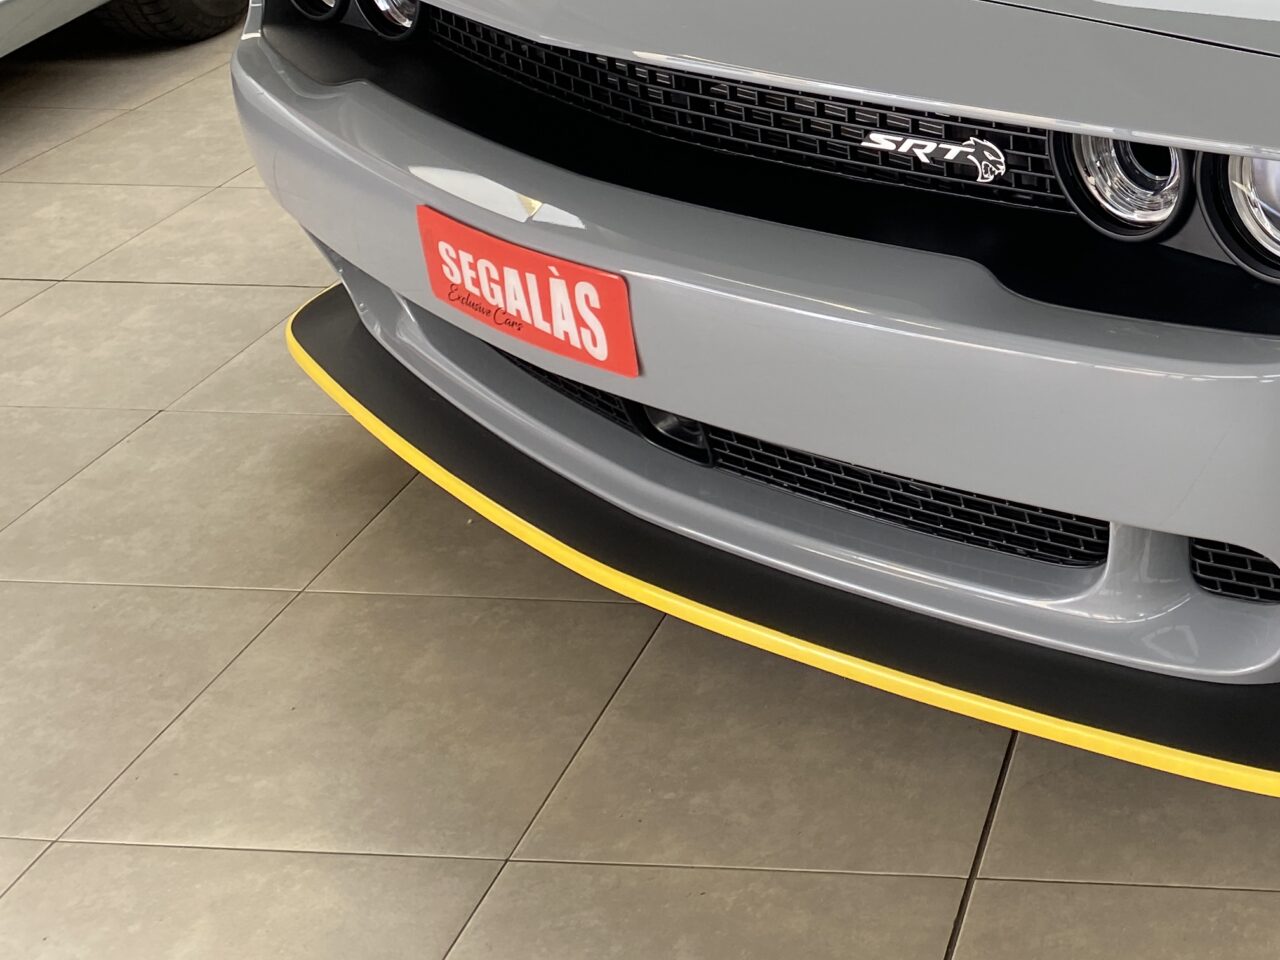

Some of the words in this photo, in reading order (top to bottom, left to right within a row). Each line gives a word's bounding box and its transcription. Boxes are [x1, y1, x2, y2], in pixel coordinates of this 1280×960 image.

[860, 132, 975, 164] SRT
[437, 241, 609, 362] SEGALÀS
[447, 283, 491, 318] Exclusive
[493, 307, 523, 332] Cars
